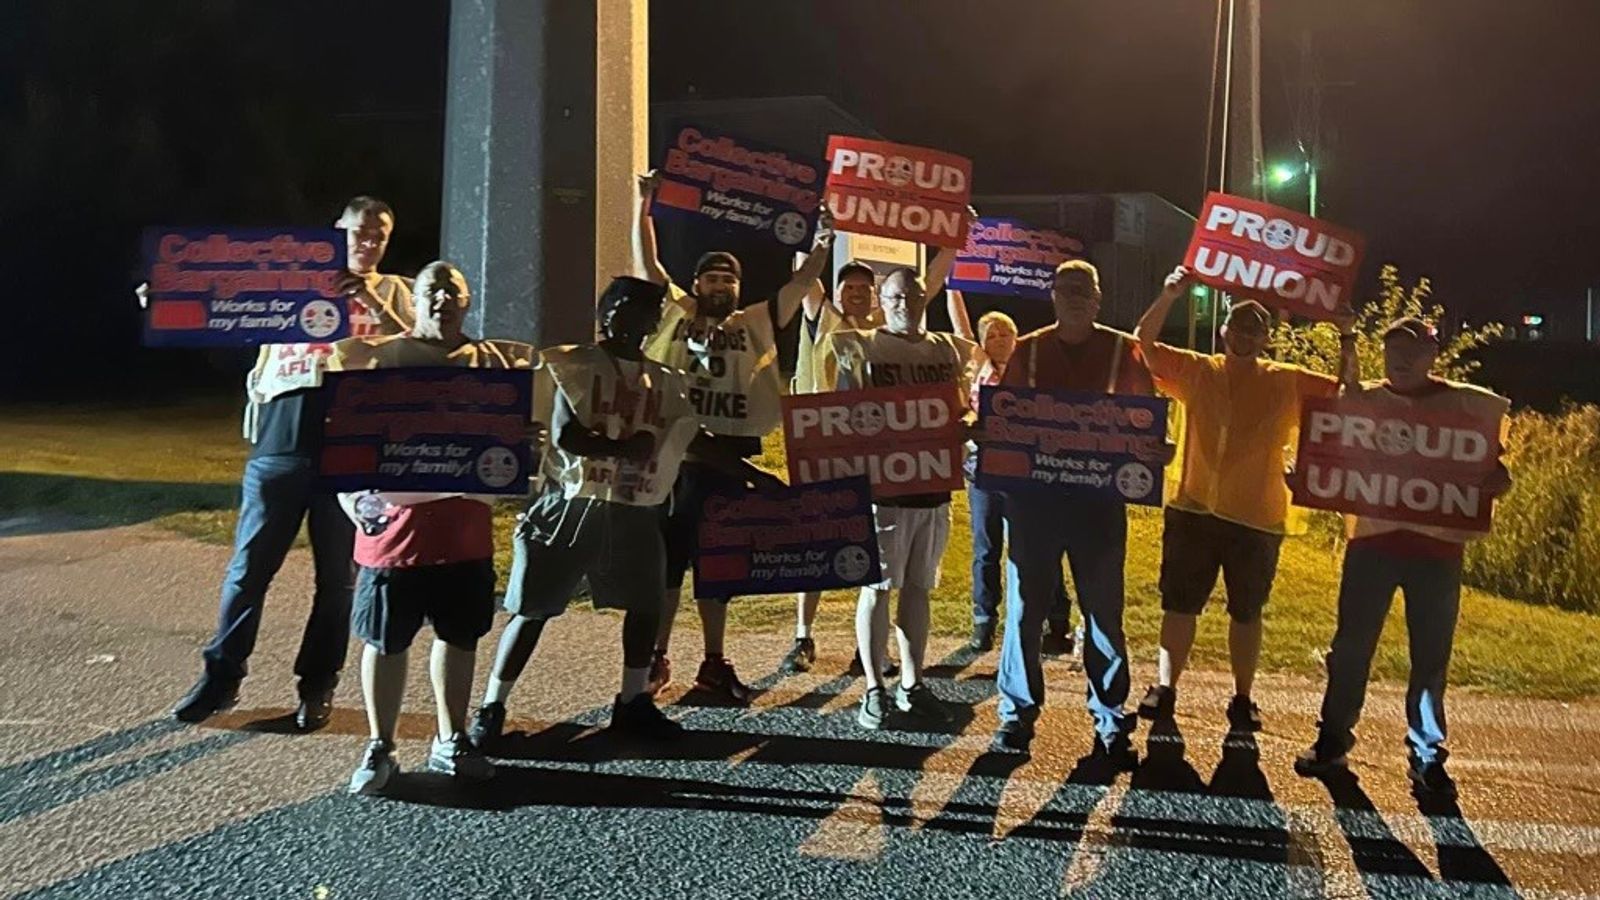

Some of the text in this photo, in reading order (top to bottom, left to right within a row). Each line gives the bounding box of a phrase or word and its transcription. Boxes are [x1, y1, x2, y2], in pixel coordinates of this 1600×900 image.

[678, 127, 817, 184] Collective
[832, 148, 965, 193] PROUD
[664, 148, 818, 214] Bargaining
[700, 205, 773, 231] my family!
[706, 190, 774, 215] Works for
[829, 193, 961, 237] UNION
[159, 234, 335, 263] Collective
[968, 221, 1084, 252] Collective
[1205, 205, 1355, 267] PROUD
[150, 263, 342, 298] Bargaining
[991, 274, 1011, 286] my
[994, 264, 1053, 278] Works for
[1194, 246, 1342, 311] UNION
[211, 297, 296, 313] Works for
[208, 313, 296, 331] my family!
[334, 376, 519, 406] Collective
[688, 387, 747, 418] RIKE
[792, 398, 949, 439] PROUD
[991, 391, 1154, 429] Collective
[382, 442, 472, 458] Works for
[985, 415, 1162, 461] Bargaining
[1310, 411, 1488, 462] PROUD
[379, 460, 473, 477] my family!
[798, 449, 952, 484] UNION
[1035, 453, 1112, 471] Works for
[1032, 470, 1112, 488] my family!
[1307, 464, 1480, 518] UNION
[751, 562, 829, 580] my family!
[752, 549, 828, 564] Works for
